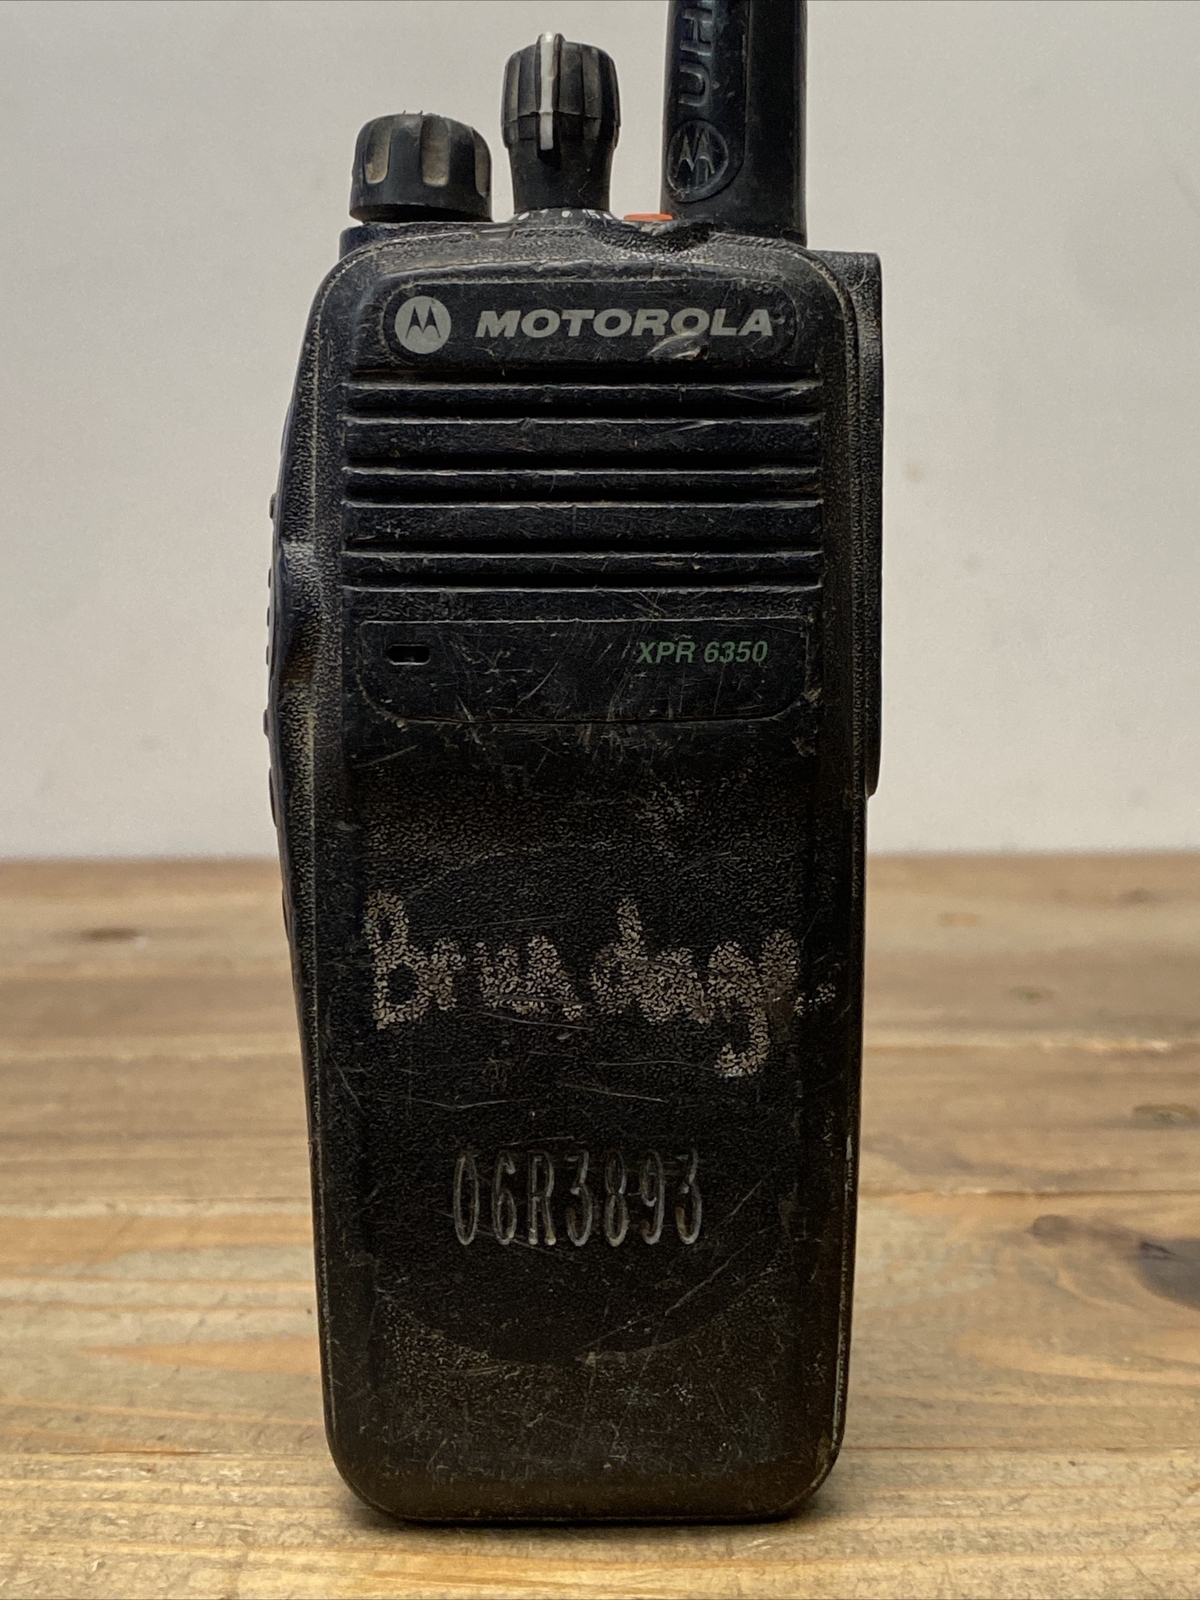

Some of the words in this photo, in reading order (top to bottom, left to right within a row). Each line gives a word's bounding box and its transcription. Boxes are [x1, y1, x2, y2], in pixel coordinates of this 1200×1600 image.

[475, 308, 774, 338] MOTOROLA
[636, 641, 696, 664] XPR
[703, 640, 768, 663] 6350
